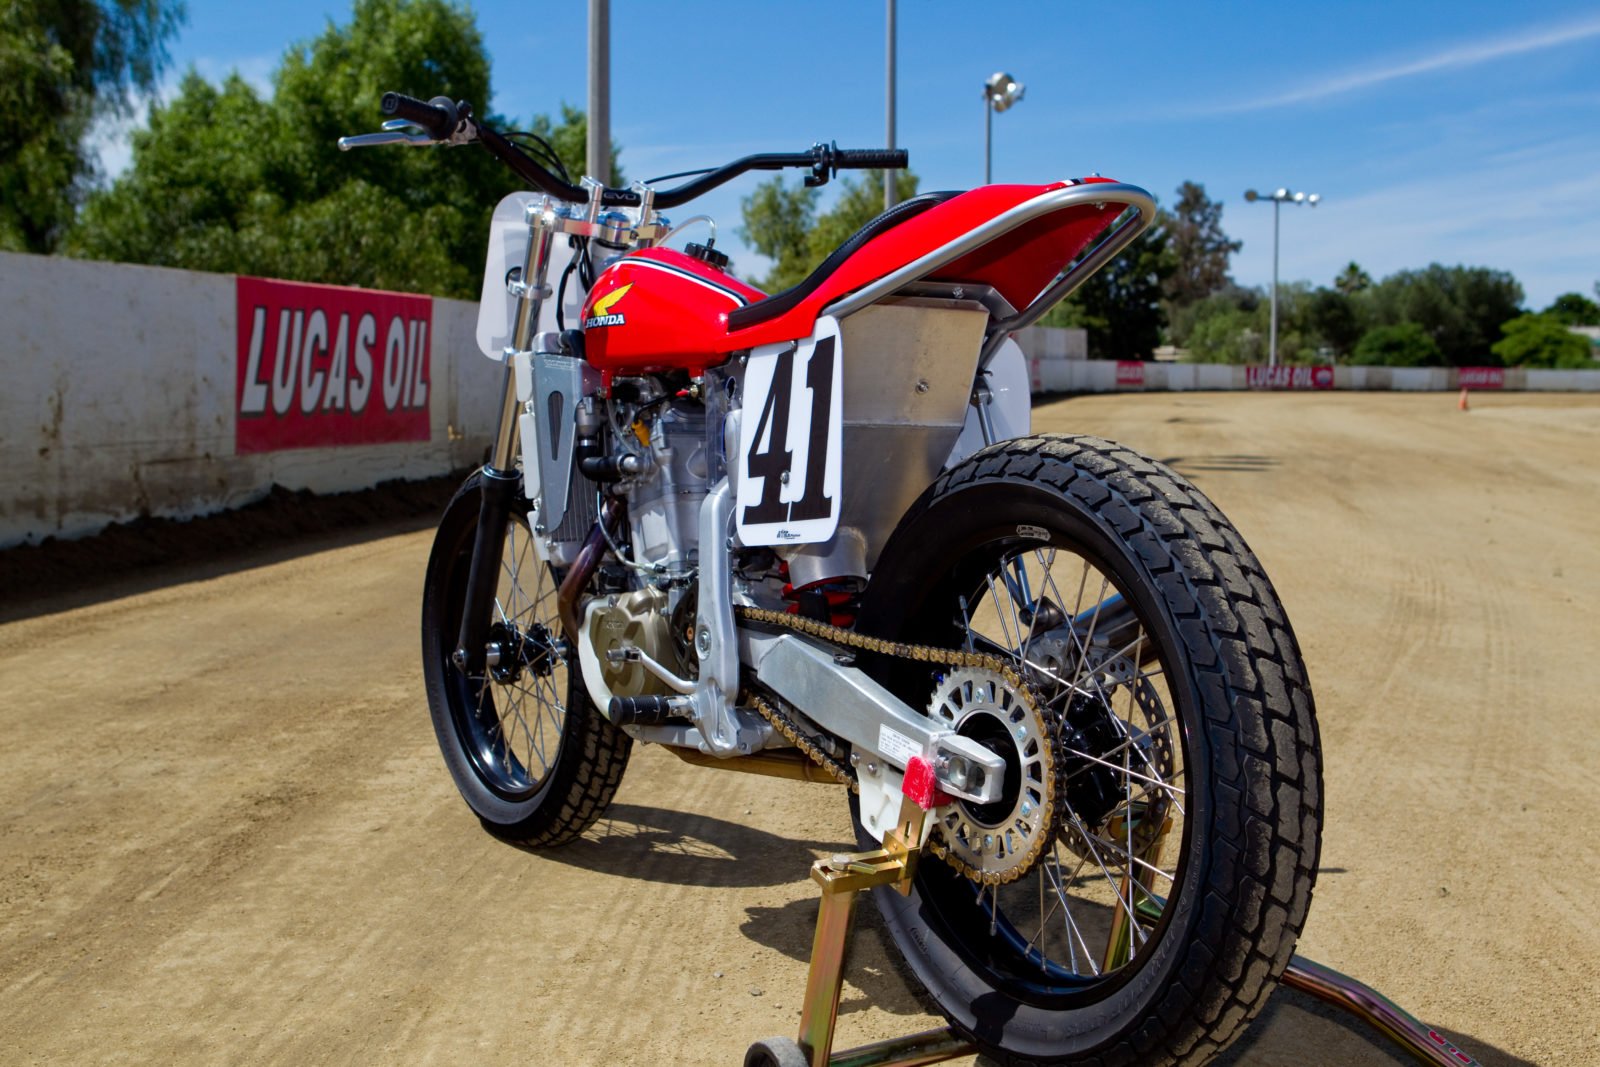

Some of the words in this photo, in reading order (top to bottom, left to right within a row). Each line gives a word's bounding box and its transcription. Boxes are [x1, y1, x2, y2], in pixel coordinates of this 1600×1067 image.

[586, 314, 625, 328] HONDA
[240, 305, 376, 417] LUCAS
[382, 315, 427, 414] OIL
[1248, 366, 1290, 387] LUCAS
[742, 334, 836, 525] 41
